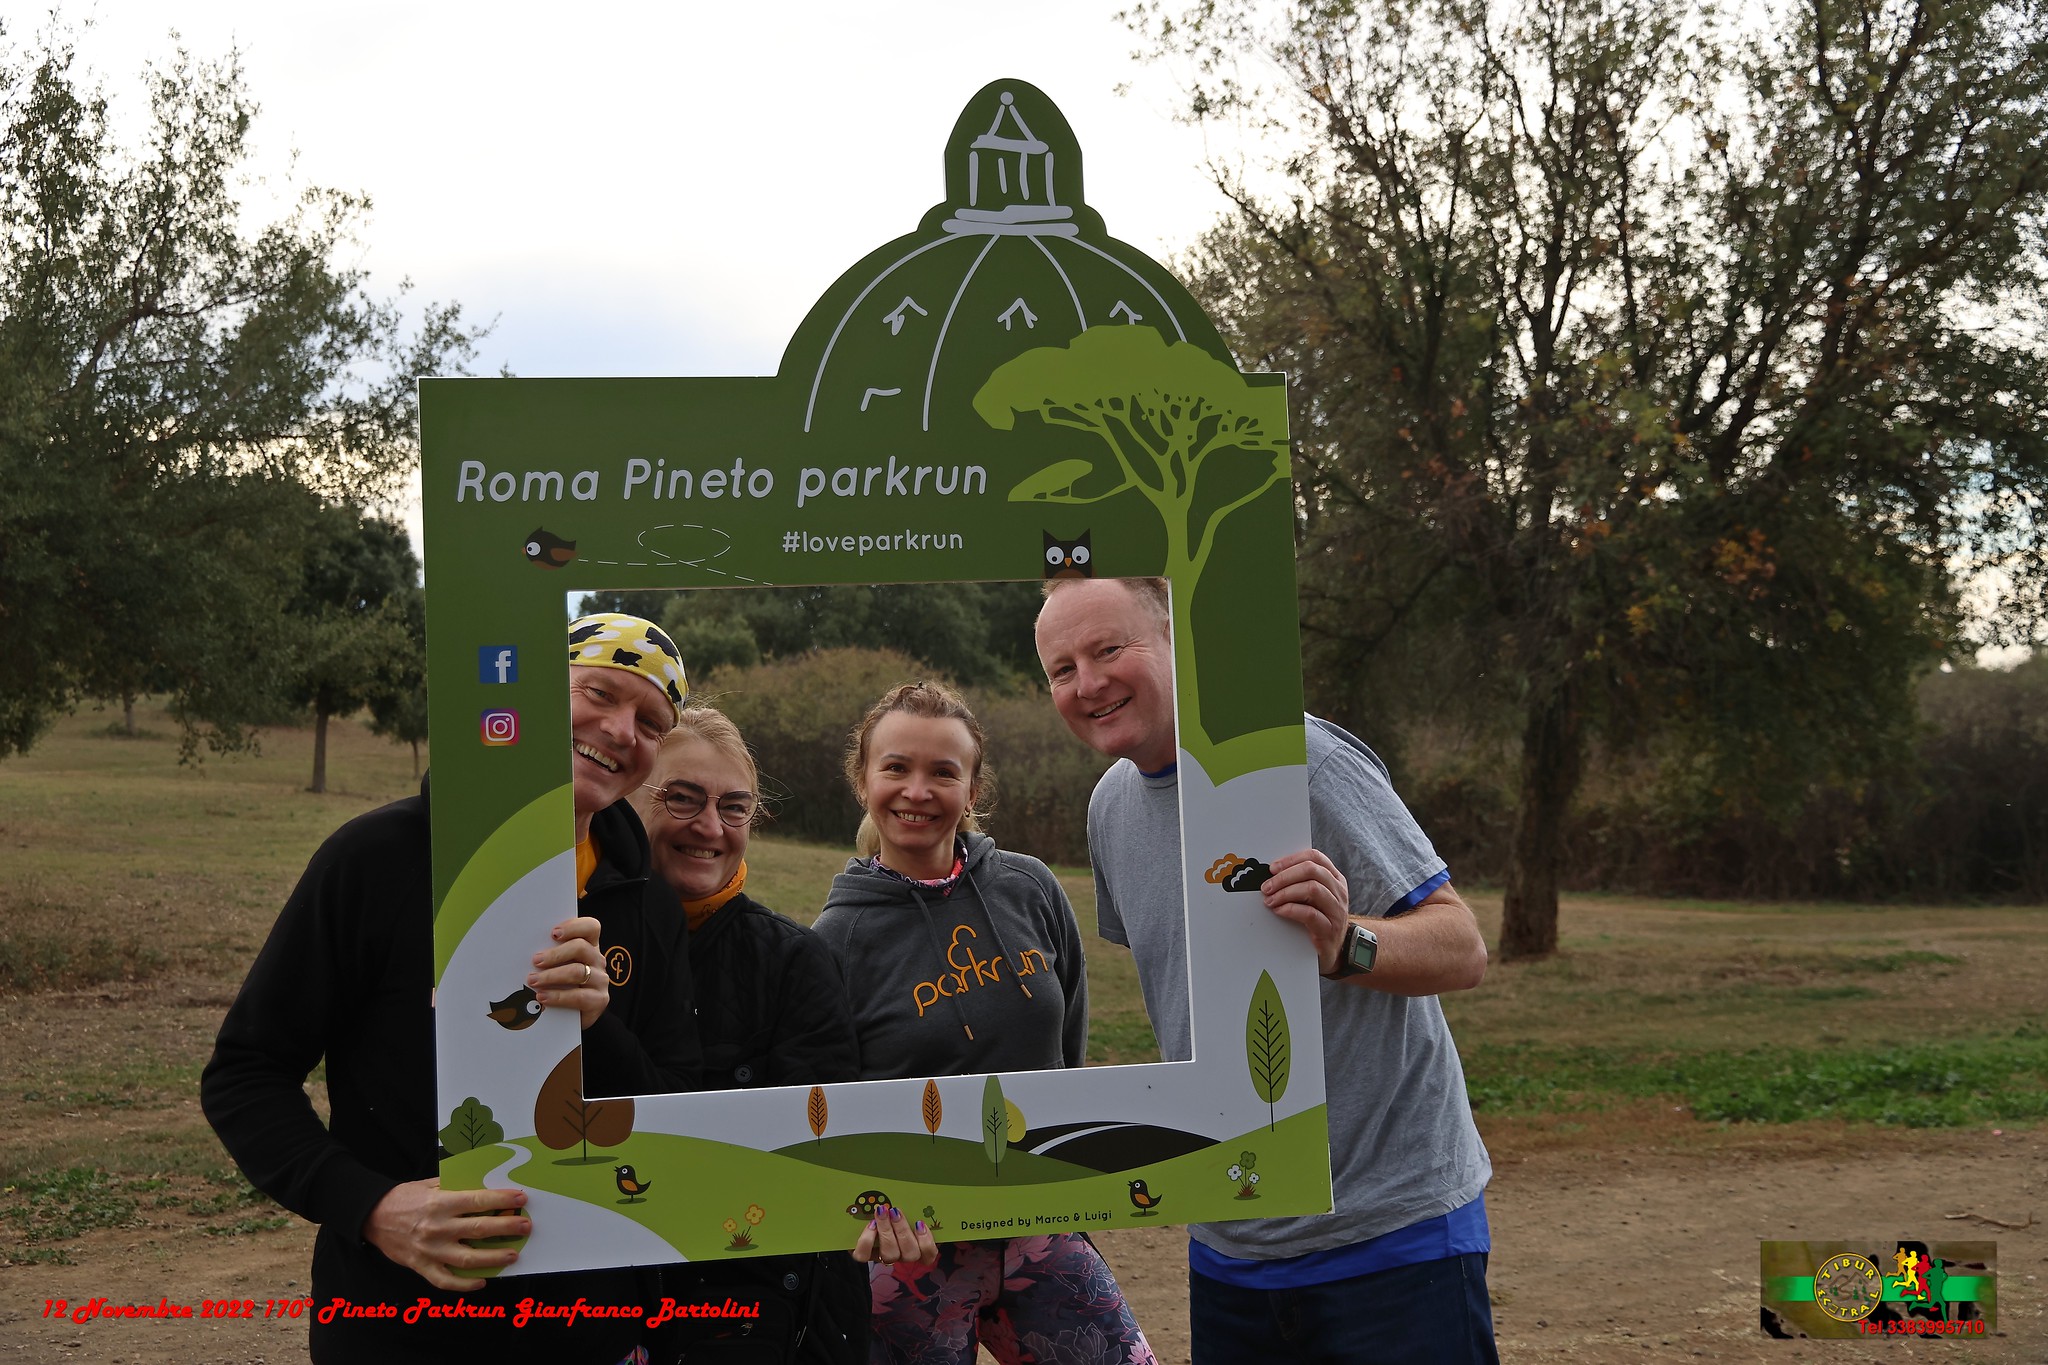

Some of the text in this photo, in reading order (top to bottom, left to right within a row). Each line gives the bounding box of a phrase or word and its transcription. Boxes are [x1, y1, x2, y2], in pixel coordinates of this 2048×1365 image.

[456, 455, 988, 508] Roma Pineto parkrun
[782, 528, 963, 557] #loveparkrun
[961, 1209, 1112, 1231] Designed by Marco & Luigi
